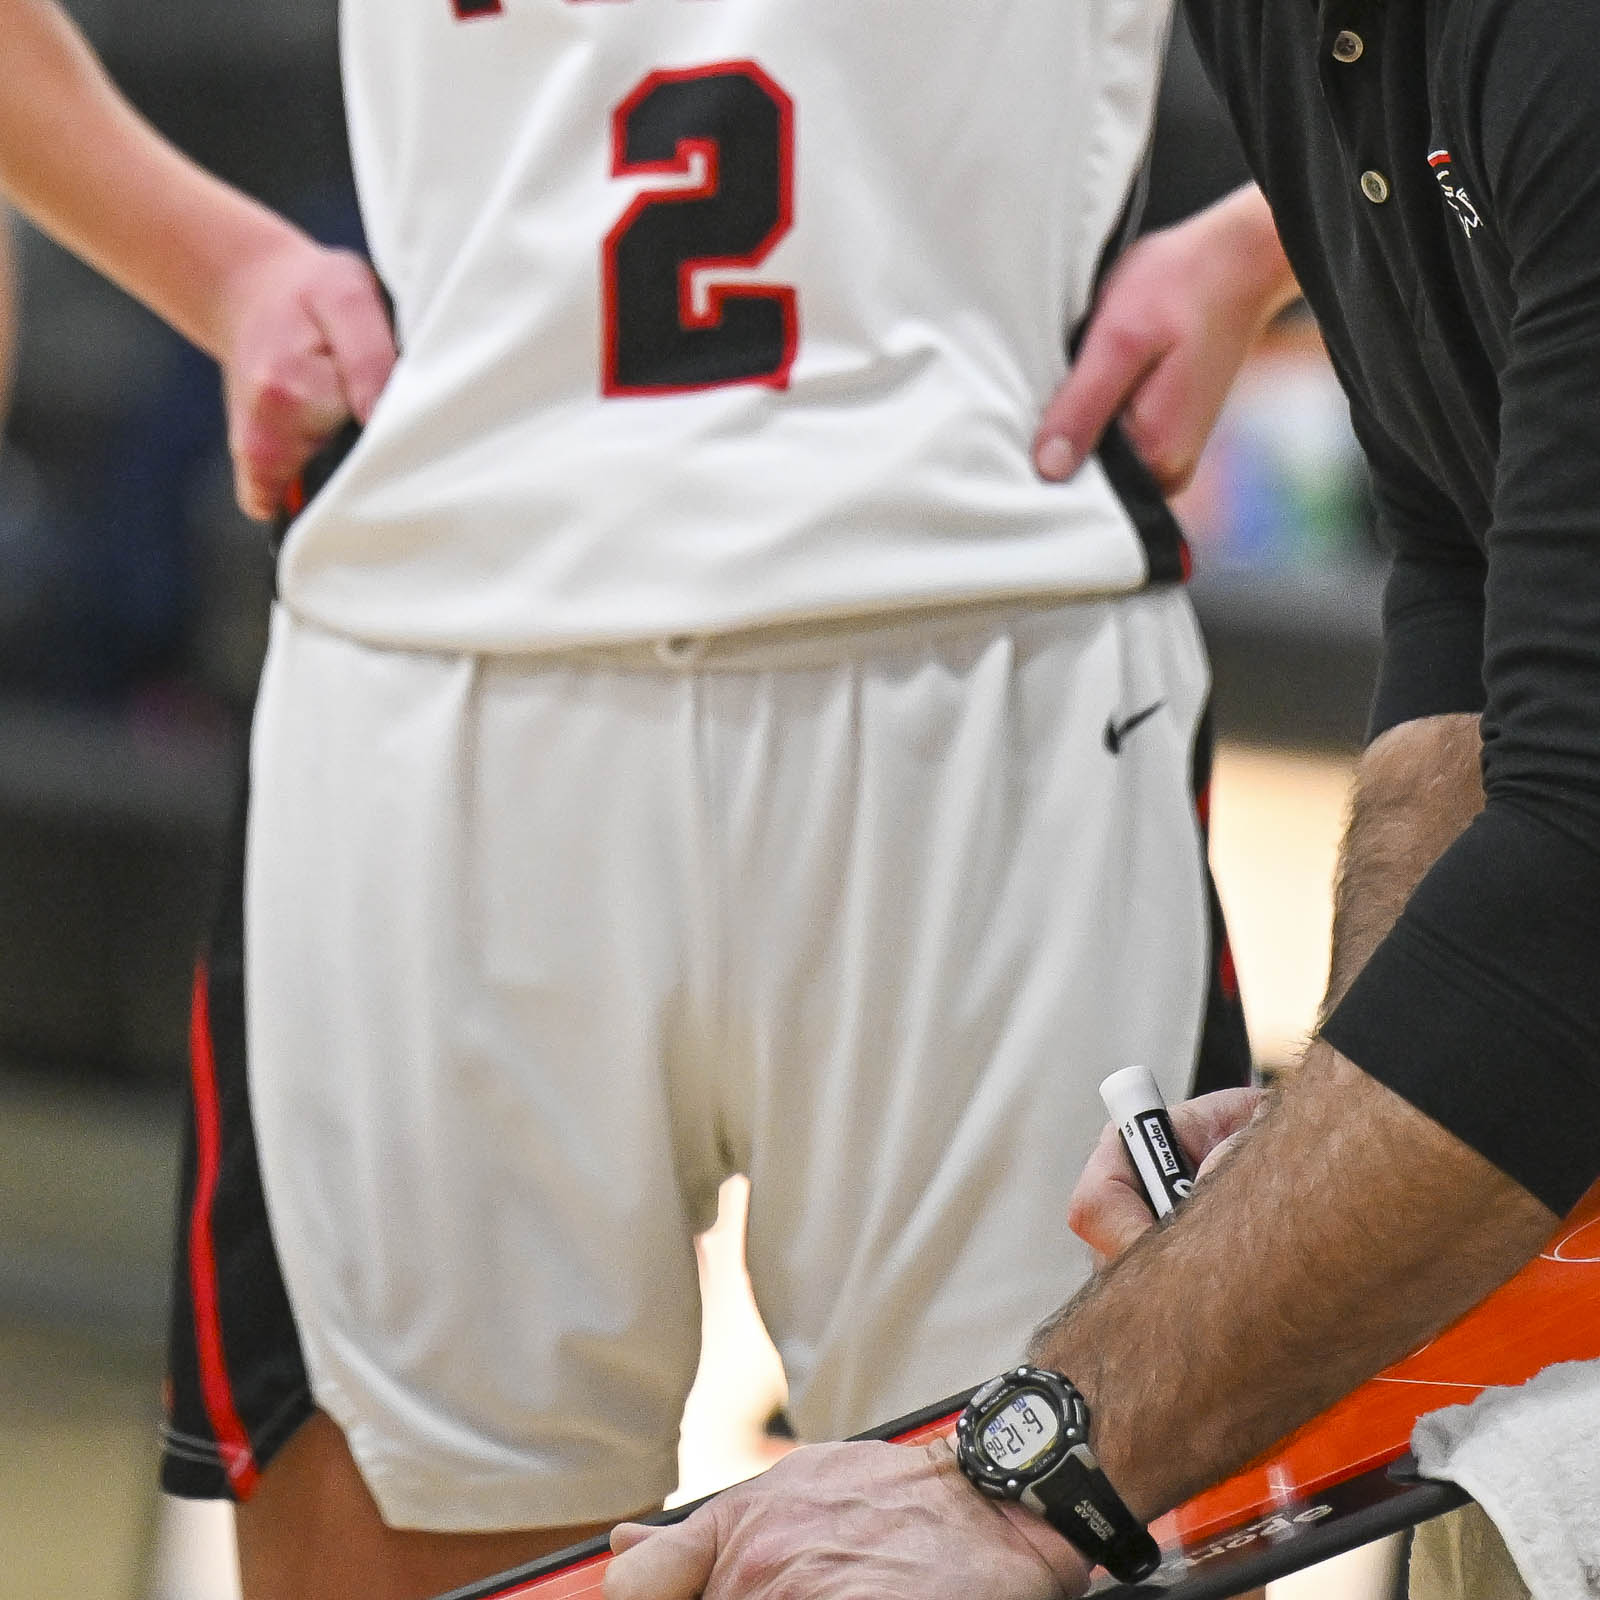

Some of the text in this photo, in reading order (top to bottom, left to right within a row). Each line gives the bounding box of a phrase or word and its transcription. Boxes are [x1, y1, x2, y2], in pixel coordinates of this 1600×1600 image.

[602, 60, 797, 398] 2
[1150, 1123, 1177, 1172] low odor
[1001, 1408, 1044, 1454] 6:12
